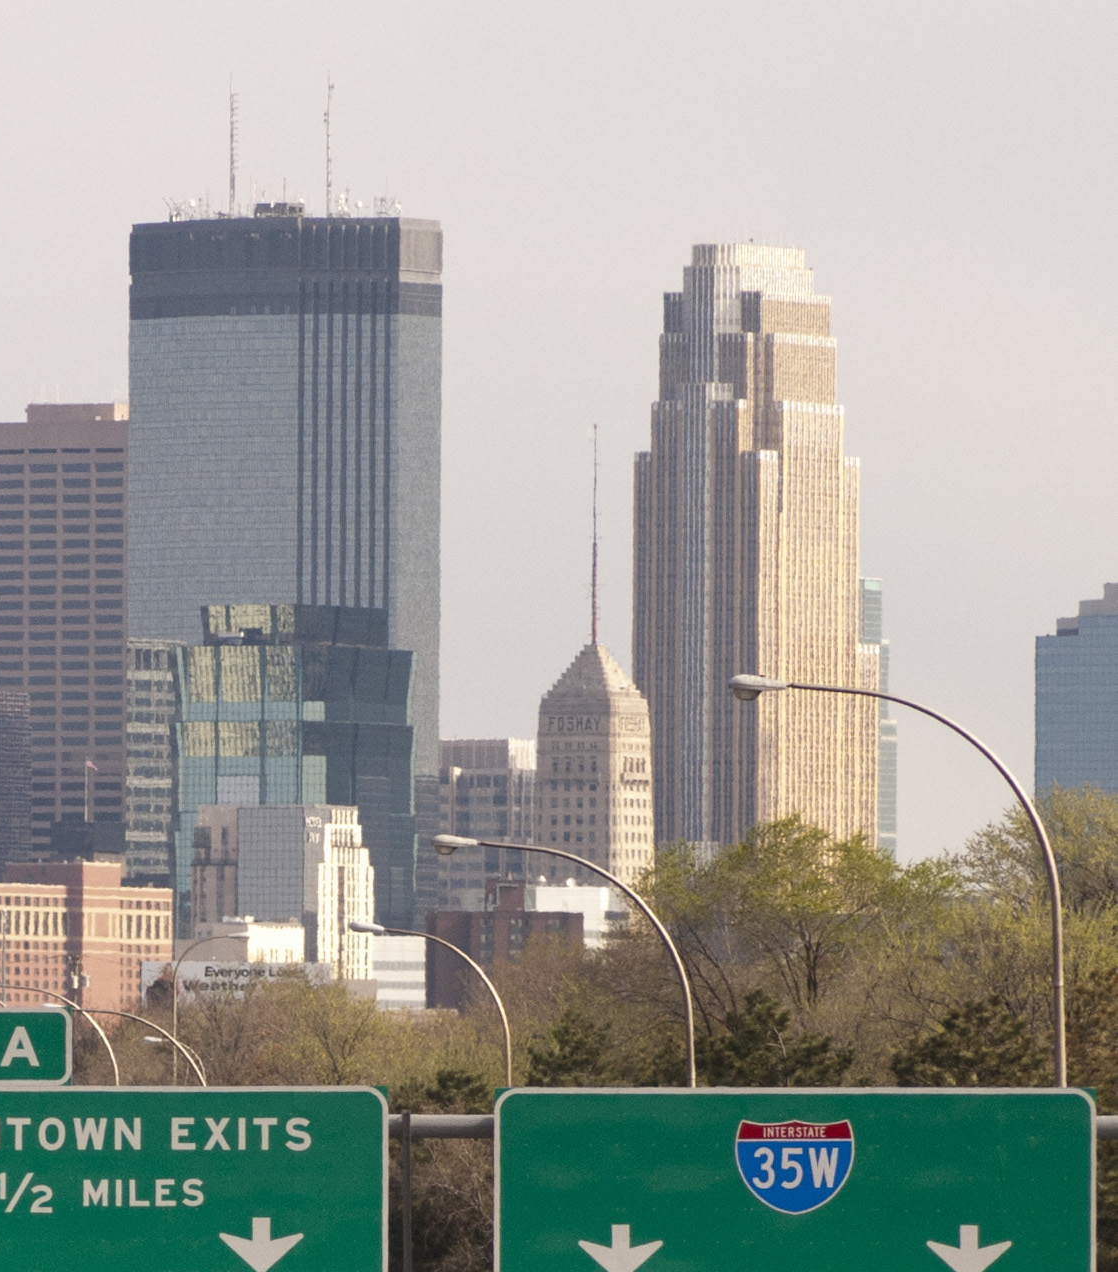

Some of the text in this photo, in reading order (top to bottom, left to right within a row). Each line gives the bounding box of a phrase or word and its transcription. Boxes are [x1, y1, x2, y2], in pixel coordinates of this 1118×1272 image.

[547, 715, 602, 732] FOSHAY
[204, 965, 266, 979] Everyone
[170, 1116, 313, 1153] EXITS
[762, 1126, 828, 1139] INTERSTATE
[752, 1146, 840, 1190] 35W
[82, 1178, 205, 1208] MILES
